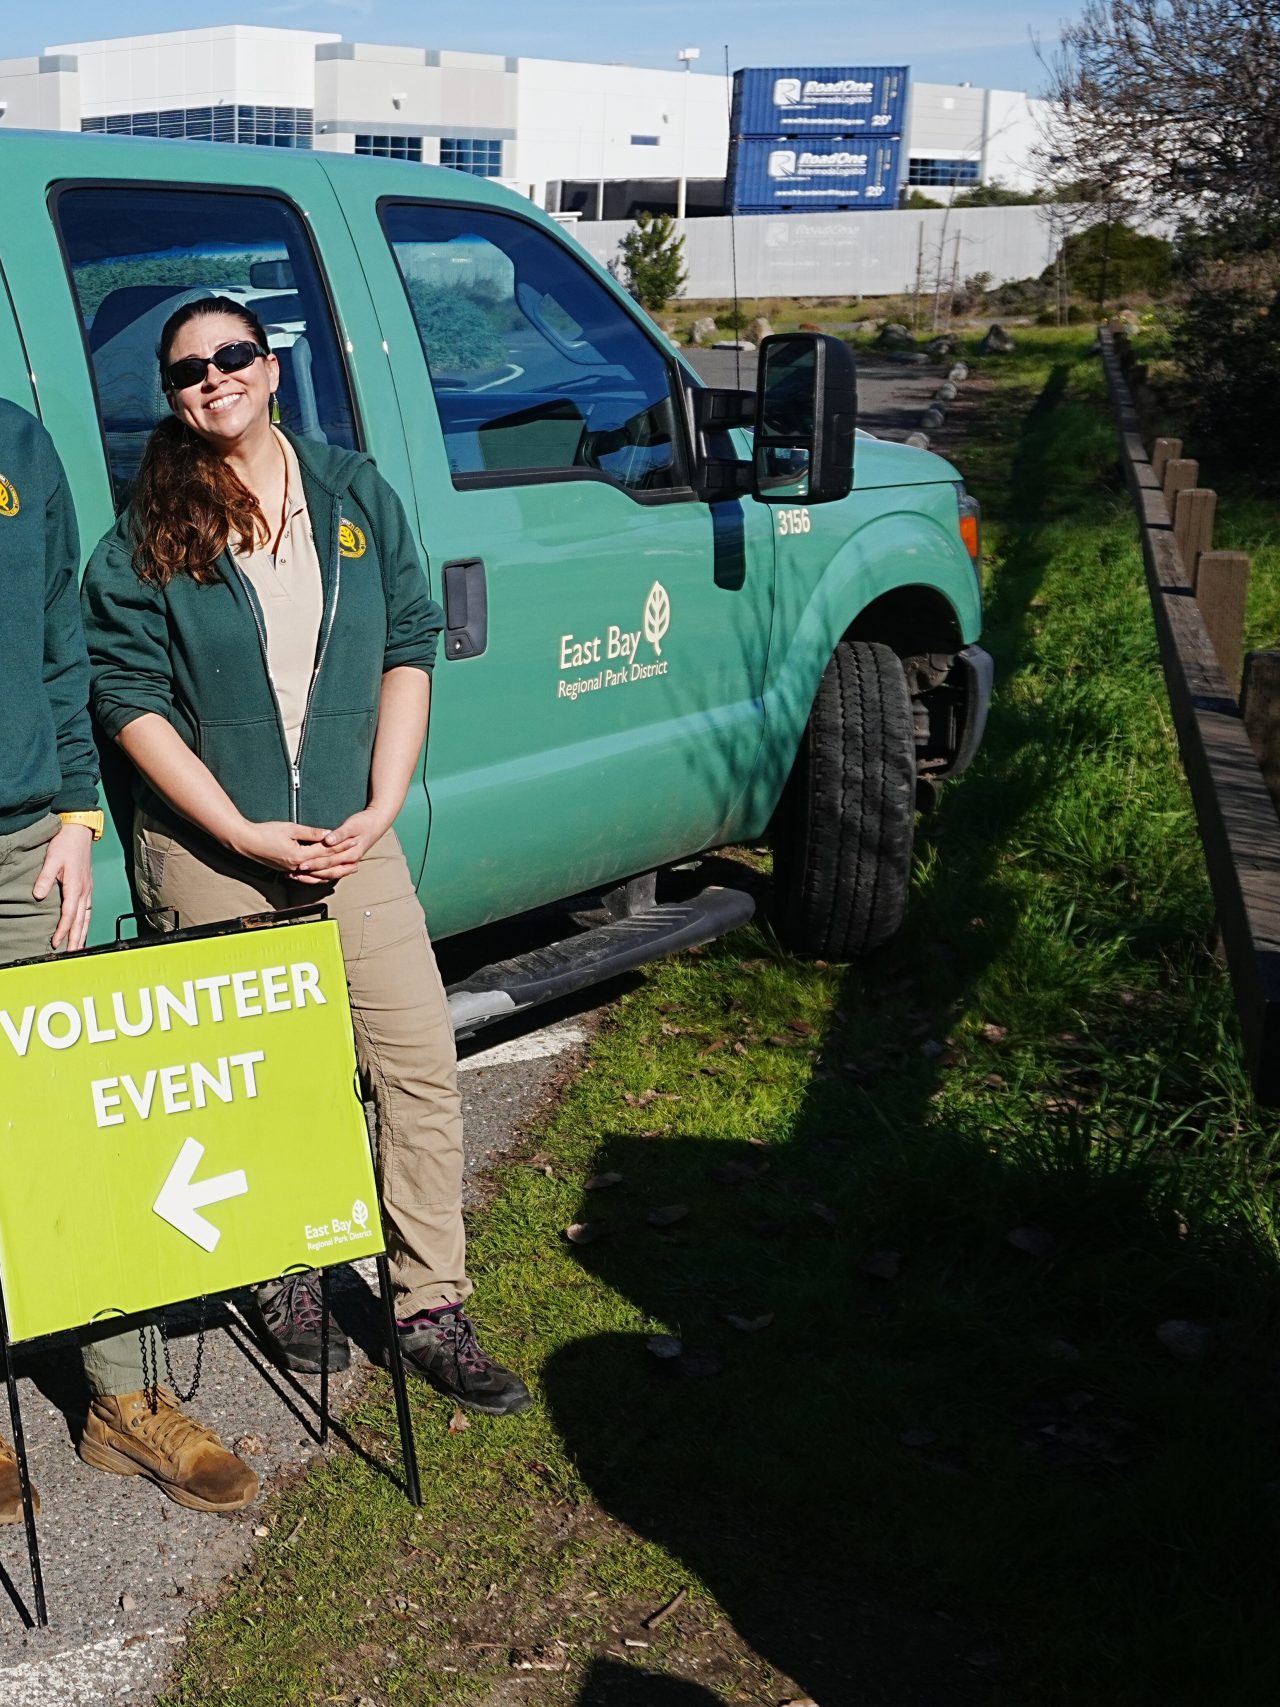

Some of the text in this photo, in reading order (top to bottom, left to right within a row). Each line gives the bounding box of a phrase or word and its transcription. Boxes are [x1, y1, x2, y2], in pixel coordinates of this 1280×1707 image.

[803, 80, 873, 92] RoadOne
[798, 152, 868, 165] RoadOne
[778, 508, 811, 535] 3156
[560, 625, 641, 669] East Bay
[558, 660, 668, 700] Regional Park District
[91, 1050, 265, 1128] EVENT
[305, 1219, 352, 1240] East Bay
[307, 1238, 334, 1251] Regional
[334, 1234, 348, 1244] Park
